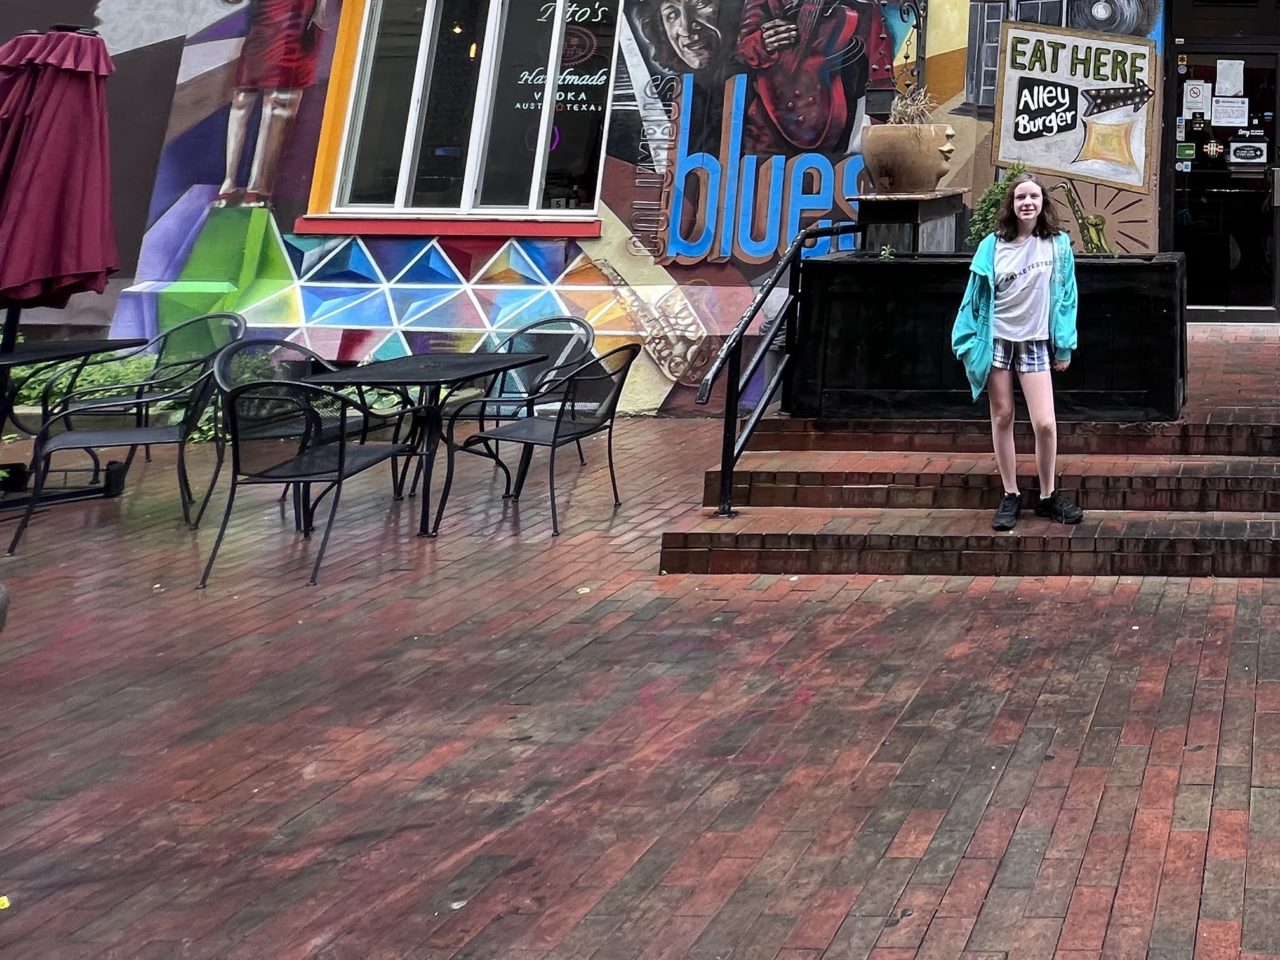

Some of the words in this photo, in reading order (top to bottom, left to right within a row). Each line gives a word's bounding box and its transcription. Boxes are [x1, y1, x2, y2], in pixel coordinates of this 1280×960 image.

[537, 1, 609, 22] Tto's
[1010, 36, 1067, 74] EAT
[1070, 44, 1147, 85] HERE
[517, 67, 609, 85] Hadmade
[514, 102, 543, 110] AUST
[533, 91, 587, 101] VDKA
[1018, 85, 1071, 113] Alley
[1014, 107, 1076, 137] Burger
[626, 74, 683, 257] COLUMBUS
[1028, 260, 1053, 270] TESTED
